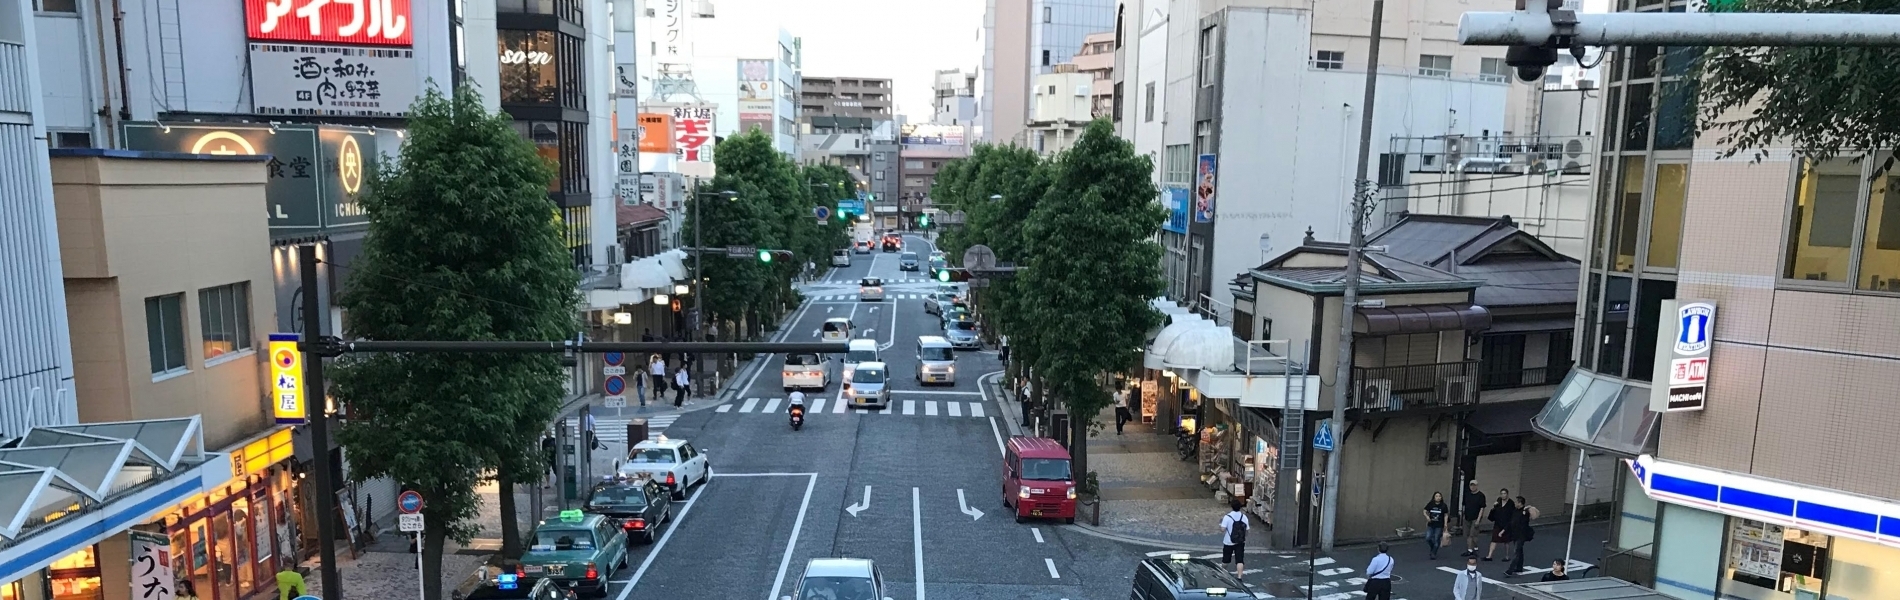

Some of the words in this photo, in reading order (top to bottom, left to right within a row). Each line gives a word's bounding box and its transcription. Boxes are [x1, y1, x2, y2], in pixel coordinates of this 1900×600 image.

[260, 0, 406, 39] アイフル
[500, 49, 553, 65] soen
[293, 57, 375, 79] 酒と和みと
[297, 91, 312, 101] 4F
[317, 77, 381, 105] 肉と野菜
[673, 107, 711, 119] 新堀
[675, 119, 711, 161] ギター
[266, 156, 311, 178] 食堂
[335, 202, 371, 217] ICHIBA
[1682, 307, 1710, 318] LAWSON
[1679, 340, 1706, 350] STATION
[1674, 363, 1686, 379] 酒
[1689, 361, 1706, 379] ATM
[278, 374, 296, 410] 松屋
[1670, 395, 1689, 403] MACHI
